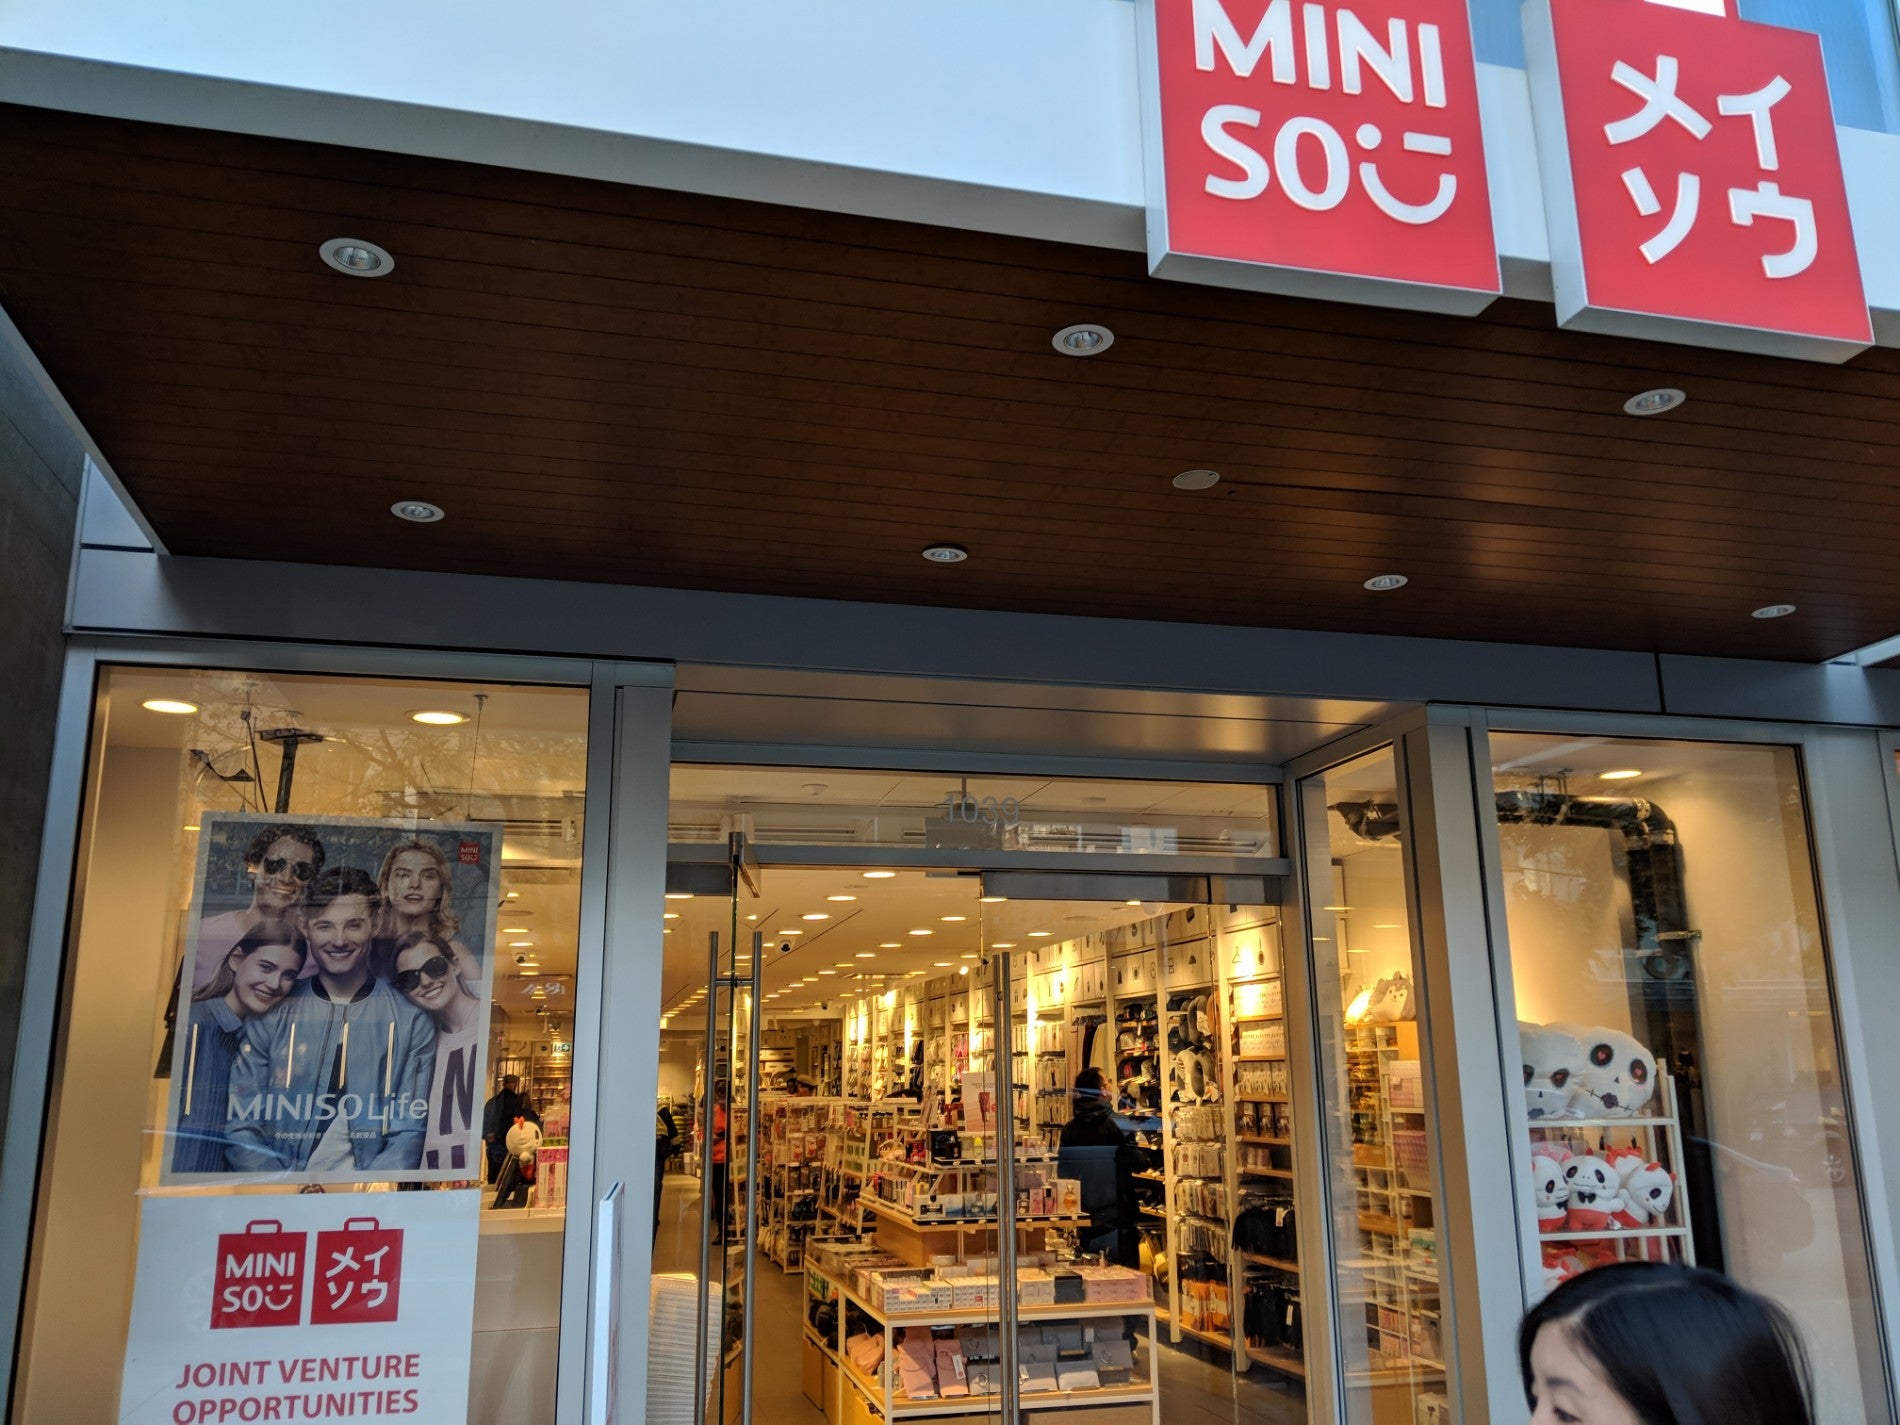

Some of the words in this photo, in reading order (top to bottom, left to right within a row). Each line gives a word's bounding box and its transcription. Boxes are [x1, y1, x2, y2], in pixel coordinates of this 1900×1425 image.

[1194, 0, 1447, 109] MINI
[943, 793, 1020, 826] 1039
[226, 1092, 363, 1121] MINISO
[367, 1091, 429, 1121] Life
[225, 1252, 296, 1279] MINI
[324, 1244, 390, 1279] メイ
[175, 1359, 273, 1390] JOINT
[277, 1353, 421, 1384] VENTURE
[172, 1388, 419, 1425] OPPORTUNITIES
